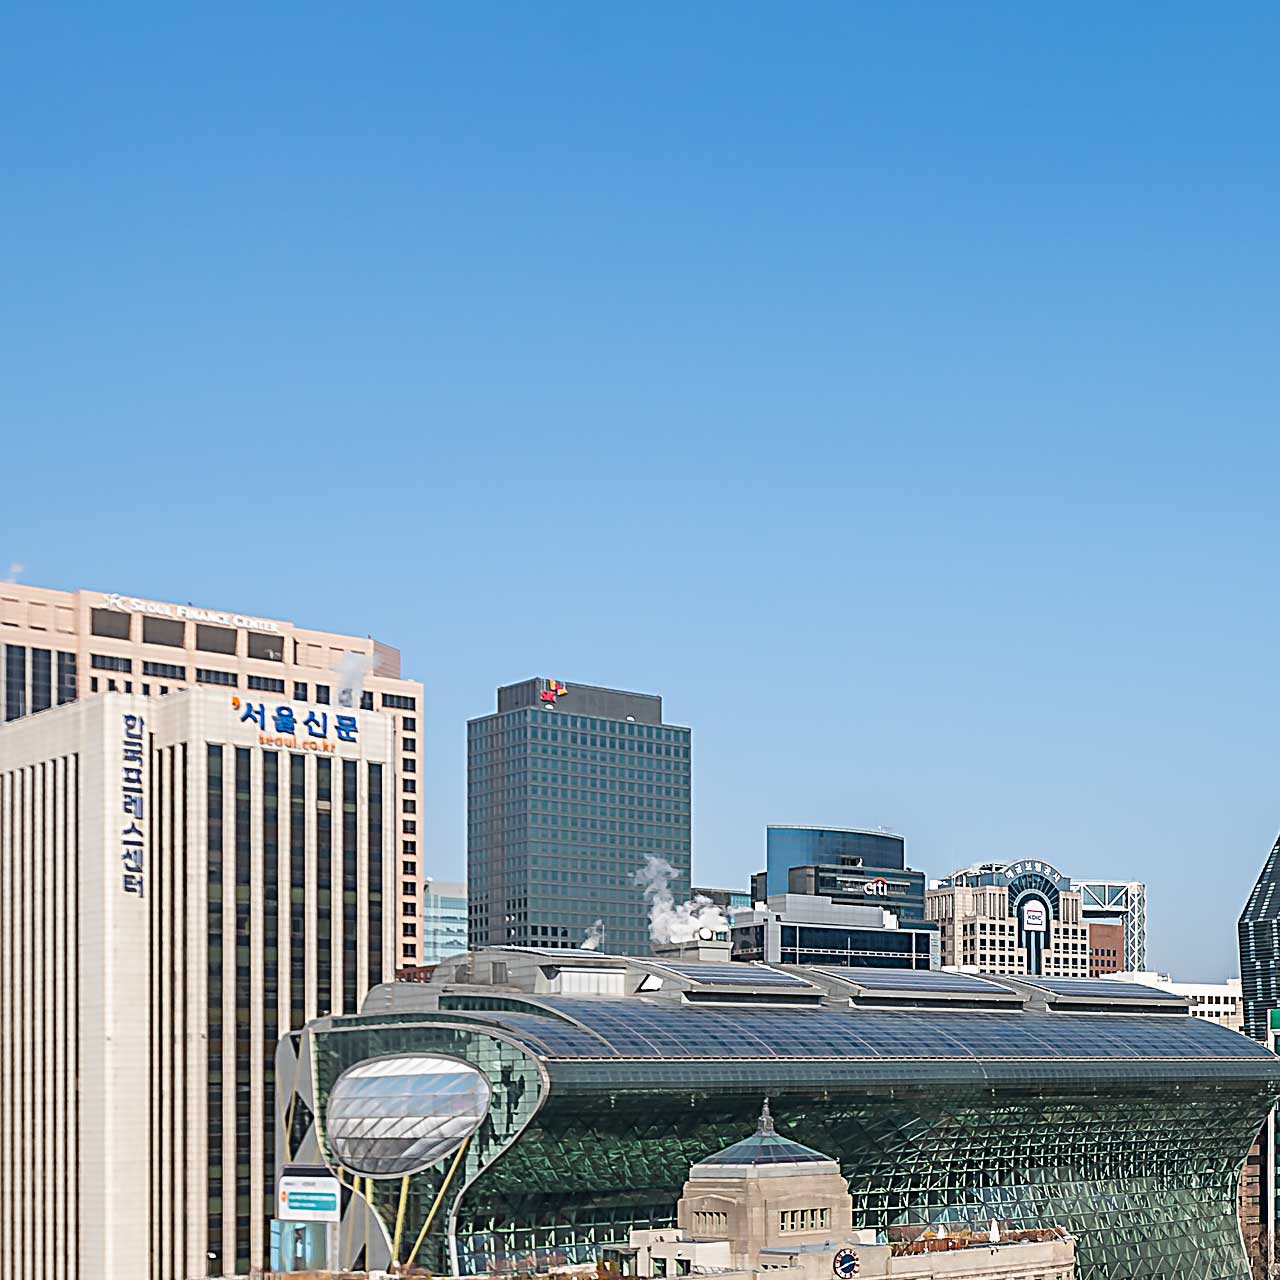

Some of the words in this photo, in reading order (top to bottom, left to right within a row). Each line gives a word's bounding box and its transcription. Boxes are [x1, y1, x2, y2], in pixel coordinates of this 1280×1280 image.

[176, 605, 231, 626] FINANCE
[232, 614, 280, 633] CENTER
[240, 702, 359, 743] 서울신문
[258, 733, 336, 752] seoul.co.kr
[121, 714, 145, 898] 한국프레스센터
[1004, 861, 1061, 883] 예금보험공사
[863, 877, 888, 897] citi
[1027, 914, 1043, 922] KDIC
